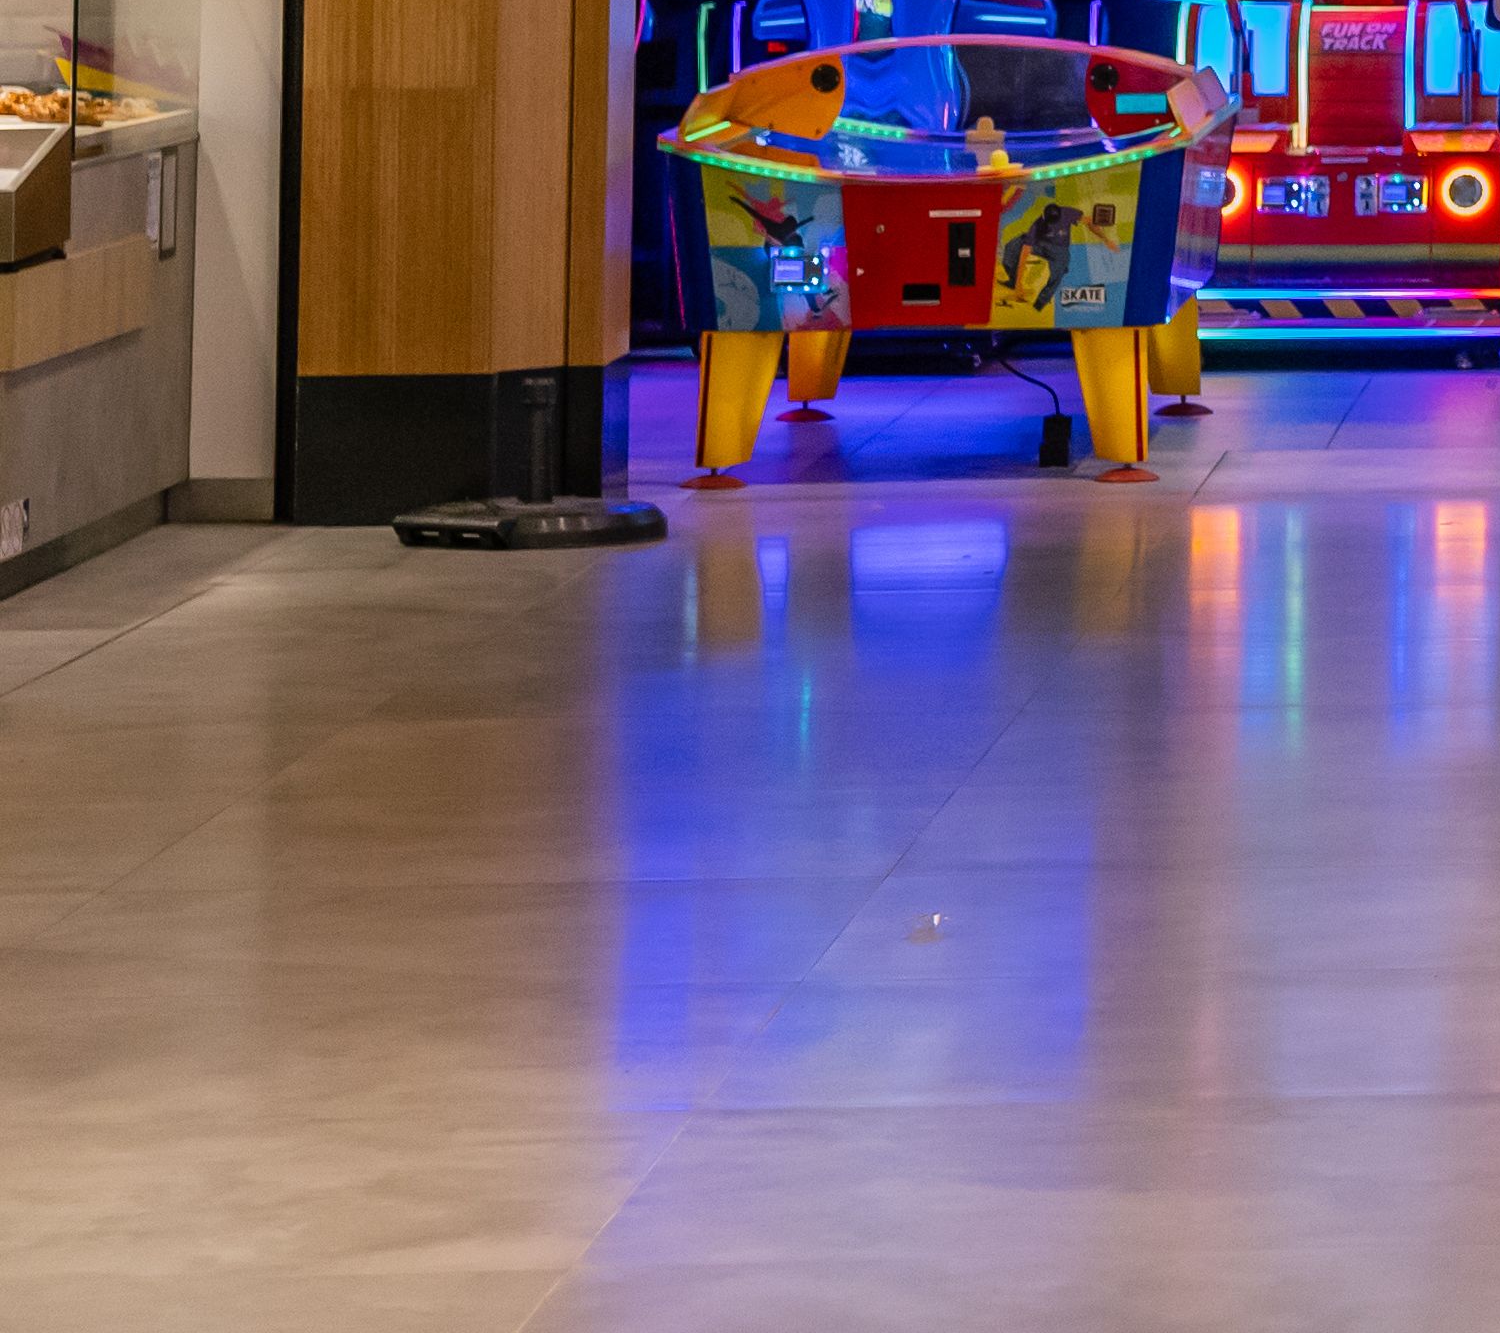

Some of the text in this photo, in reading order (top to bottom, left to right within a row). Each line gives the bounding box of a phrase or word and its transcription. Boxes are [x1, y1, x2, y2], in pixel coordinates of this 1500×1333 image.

[1320, 22, 1398, 38] FUN ON
[1322, 35, 1389, 51] TRACK
[1062, 288, 1103, 303] SKATE
